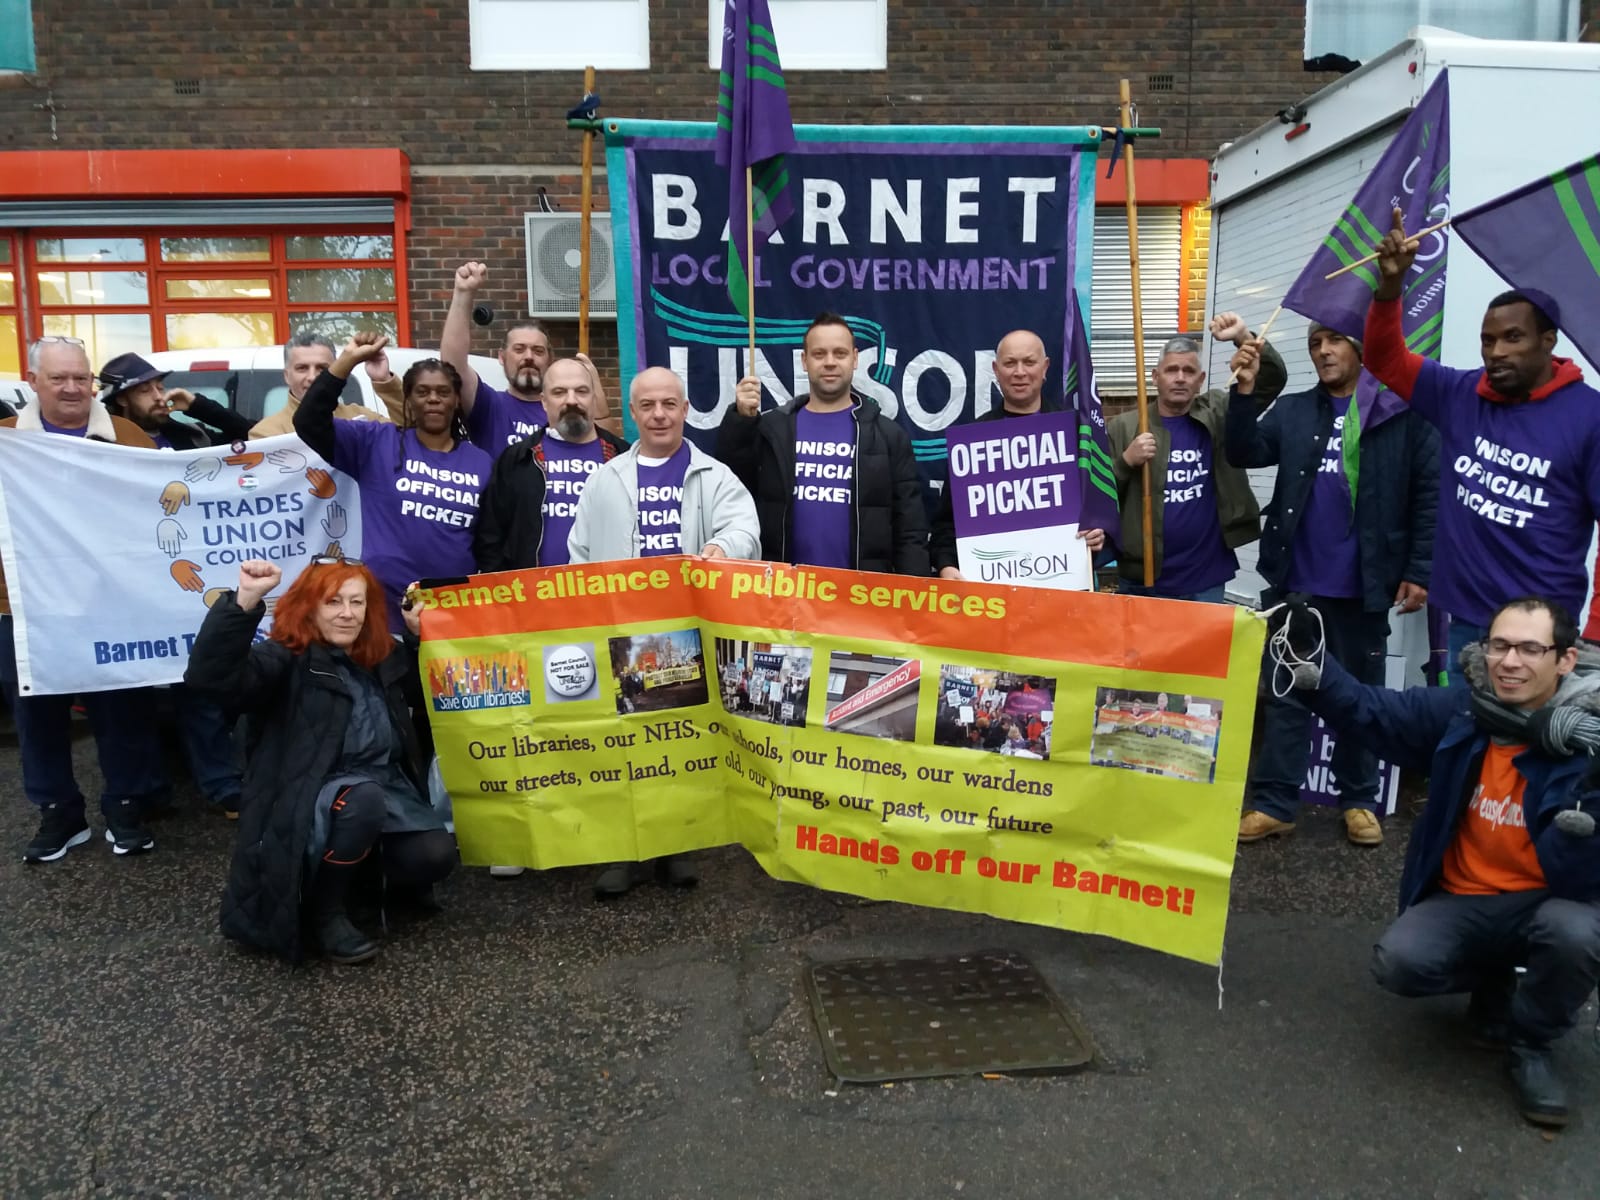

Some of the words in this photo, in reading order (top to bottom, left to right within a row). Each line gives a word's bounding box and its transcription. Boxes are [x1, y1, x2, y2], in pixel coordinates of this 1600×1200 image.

[651, 173, 1056, 245] BRNET
[651, 252, 772, 288] LOCL
[790, 254, 1056, 291] GOVERNMENT
[669, 345, 1004, 432] UNSO
[951, 430, 1075, 478] OFFICIAL
[405, 459, 480, 487] UNISON
[197, 492, 304, 520] TRADES
[395, 477, 480, 508] OFFICIAL
[967, 474, 1065, 518] PICKET
[1457, 483, 1534, 528] PICKET
[202, 517, 305, 546] UNION
[401, 499, 474, 528] PICKET
[205, 540, 307, 566] COUNCILS
[980, 553, 1069, 582] UNISON
[415, 577, 527, 610] Barnet
[536, 569, 670, 600] alliance
[680, 561, 722, 590] for
[731, 569, 838, 601] public
[849, 584, 1006, 619] services
[93, 636, 180, 665] Barnet
[438, 692, 461, 710] Save
[461, 694, 483, 708] our
[484, 685, 526, 707] libraries!
[864, 667, 912, 701] Emergency
[468, 741, 506, 761] Our
[512, 735, 597, 758] libraries,
[604, 732, 637, 749] our
[643, 719, 701, 744] NHS,
[792, 749, 828, 766] our
[835, 746, 907, 781] homes,
[917, 766, 955, 784] our
[962, 769, 1054, 797] wardens
[479, 777, 508, 793] our
[515, 770, 582, 792] streets,
[589, 767, 622, 783] our
[627, 756, 677, 782] land,
[684, 754, 718, 773] our
[725, 750, 745, 778] old,
[748, 768, 767, 788] our
[769, 780, 831, 810] young,
[838, 792, 874, 812] our
[881, 799, 930, 823] past,
[940, 808, 979, 826] our
[987, 806, 1054, 834] future
[796, 825, 900, 865] Hands
[911, 848, 967, 875] off
[977, 857, 1041, 884] our
[1052, 861, 1196, 916] Barnet!
